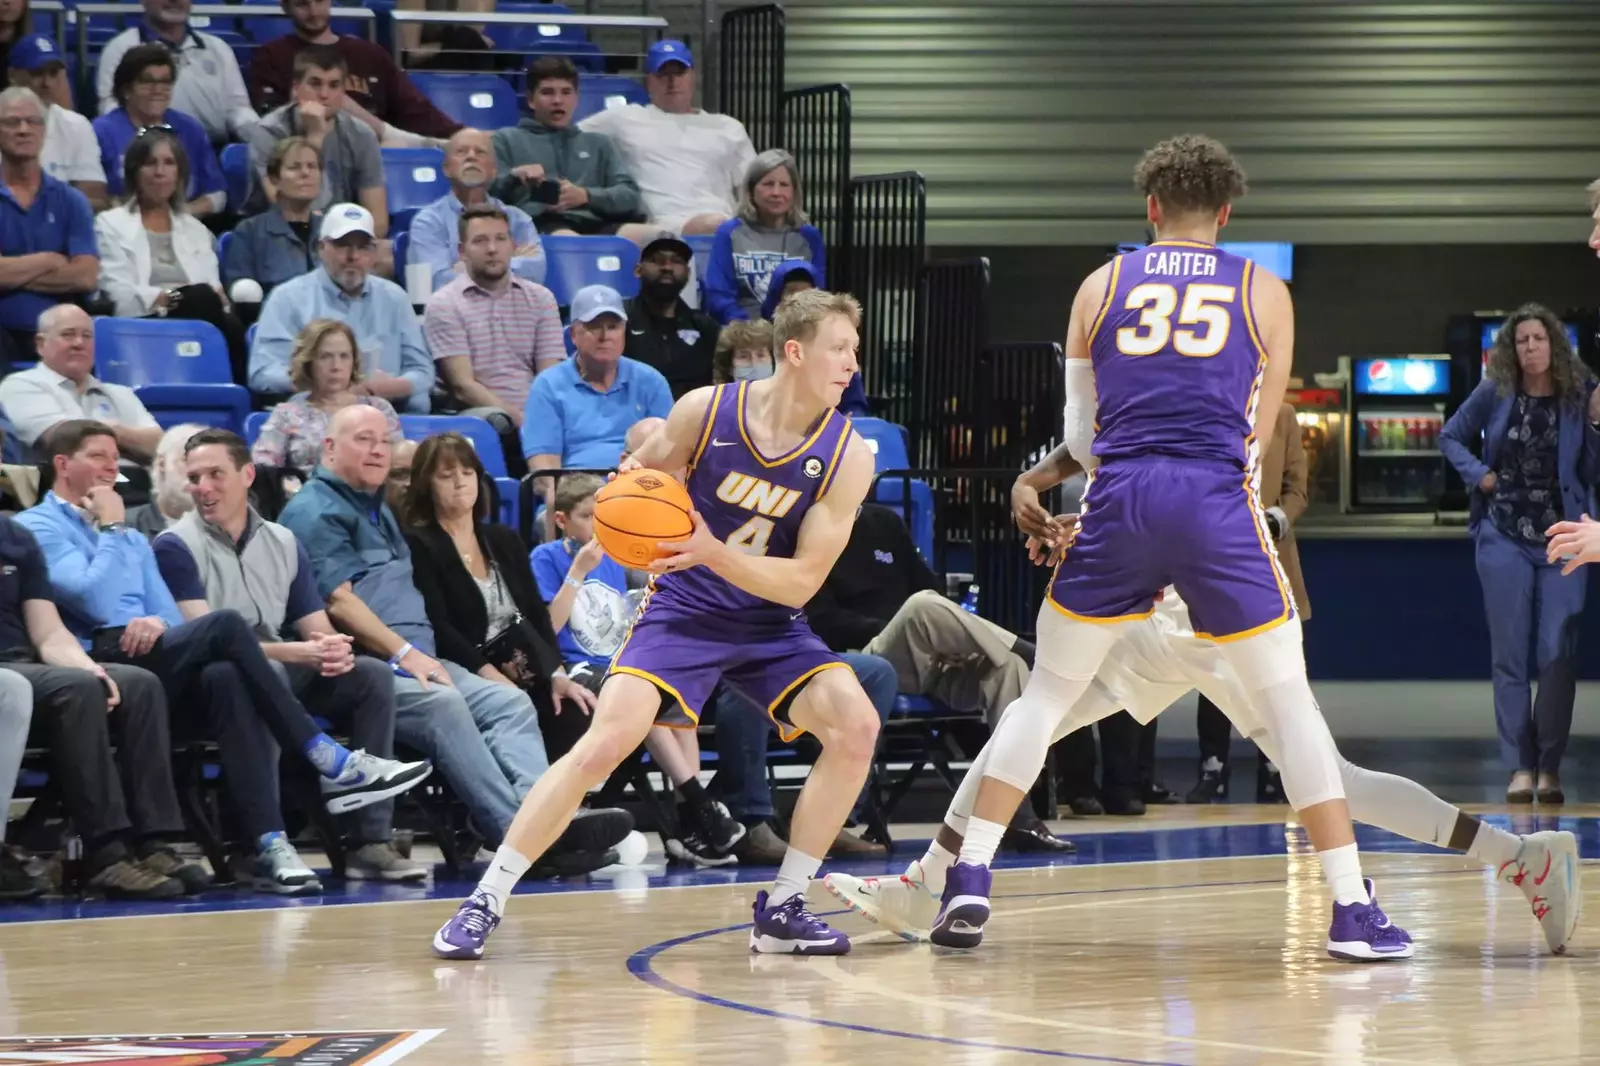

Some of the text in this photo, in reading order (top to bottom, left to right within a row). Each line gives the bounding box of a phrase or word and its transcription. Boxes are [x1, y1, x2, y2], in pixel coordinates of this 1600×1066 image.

[1144, 251, 1217, 276] CARTER
[1115, 282, 1236, 357] 35
[715, 470, 802, 518] UNI
[724, 515, 775, 556] 4
